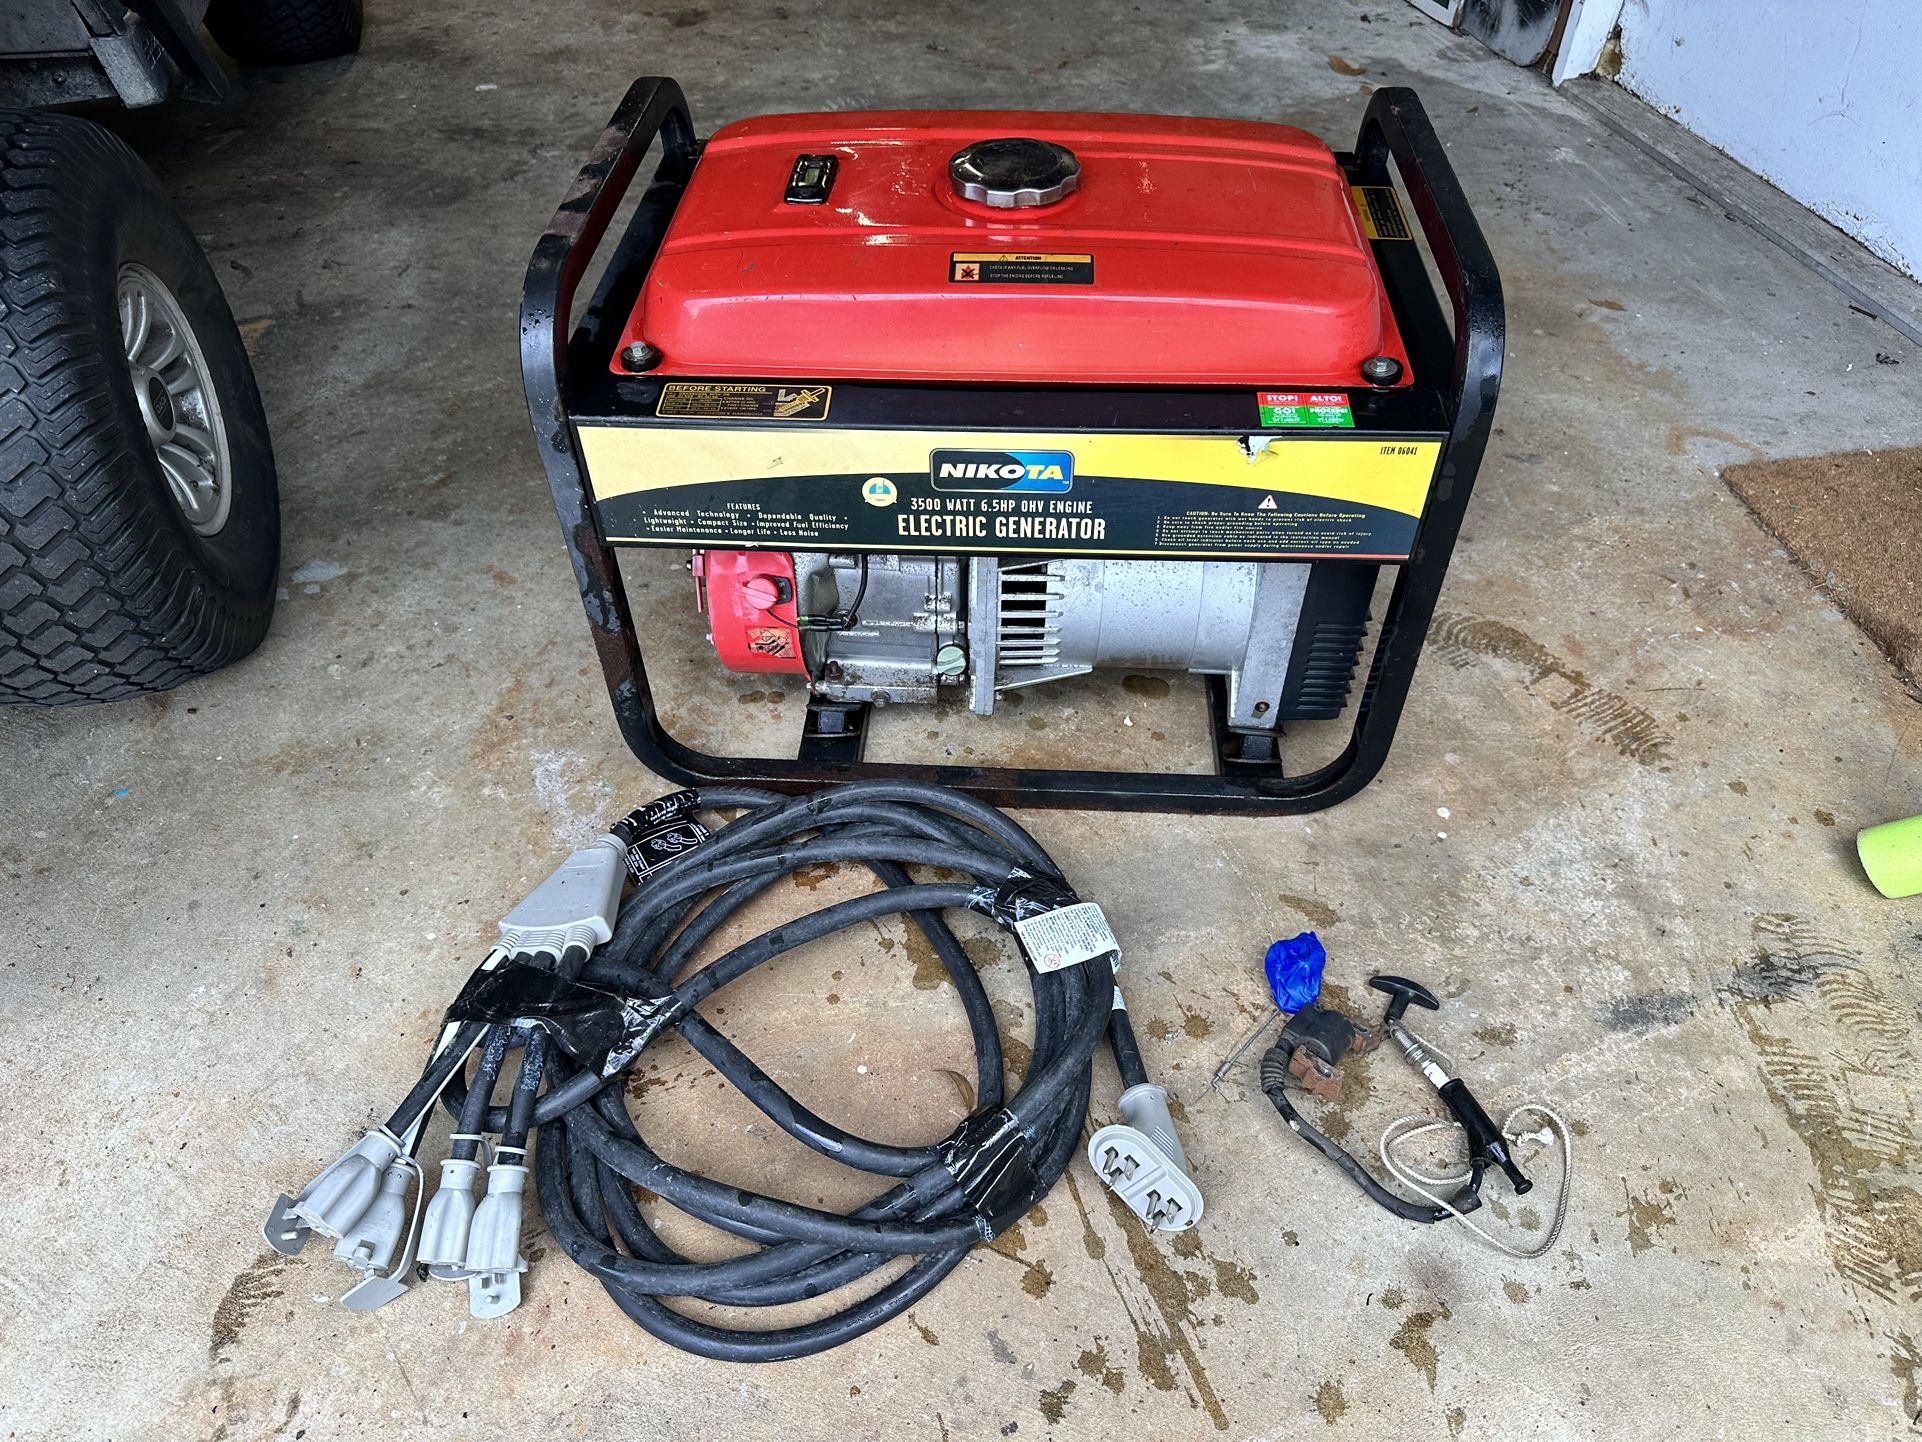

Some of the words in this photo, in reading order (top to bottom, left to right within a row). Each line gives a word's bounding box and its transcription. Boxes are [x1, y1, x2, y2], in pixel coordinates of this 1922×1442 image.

[1380, 446, 1396, 455] ITEM
[1397, 447, 1418, 456] 06041
[939, 463, 1063, 480] NIKOTA
[910, 498, 941, 510] 3500
[946, 498, 975, 511] WATT
[981, 499, 1016, 512] 6.5HP
[1021, 500, 1044, 513] OHV
[1049, 501, 1093, 514] ENGINE
[697, 510, 739, 519] Technology
[809, 514, 836, 522] Quality
[644, 517, 687, 525] Lightweight
[698, 518, 729, 526] Compact
[812, 522, 849, 531] Efficiency
[898, 514, 987, 537] ELECTRIC
[995, 517, 1106, 540] GENERATOR
[888, 1293, 909, 1307] TYPE
